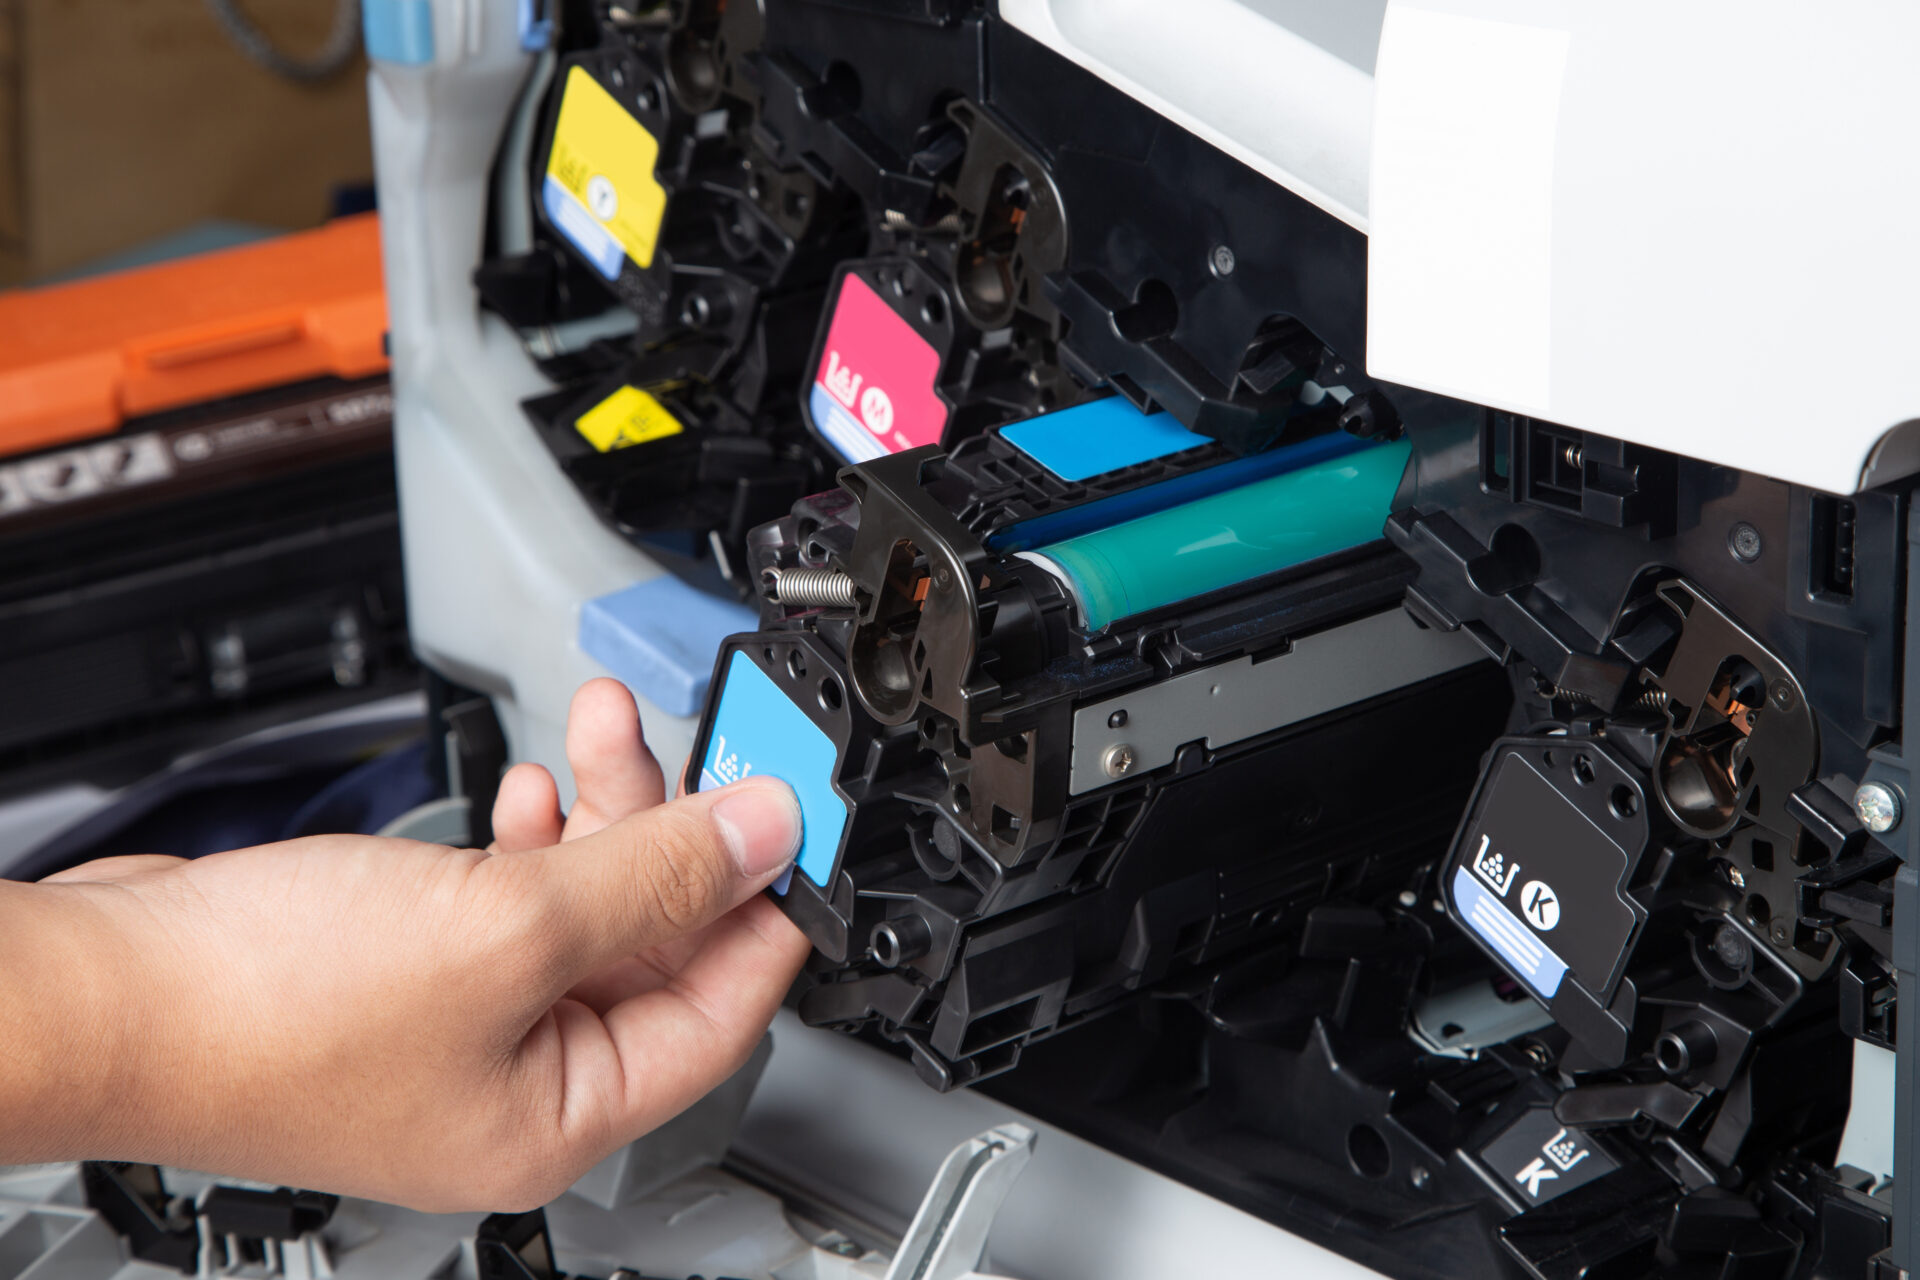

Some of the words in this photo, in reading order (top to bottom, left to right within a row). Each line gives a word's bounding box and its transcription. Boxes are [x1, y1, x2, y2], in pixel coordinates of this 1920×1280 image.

[866, 394, 886, 426] M
[1528, 887, 1554, 925] K
[1515, 1157, 1559, 1197] K
